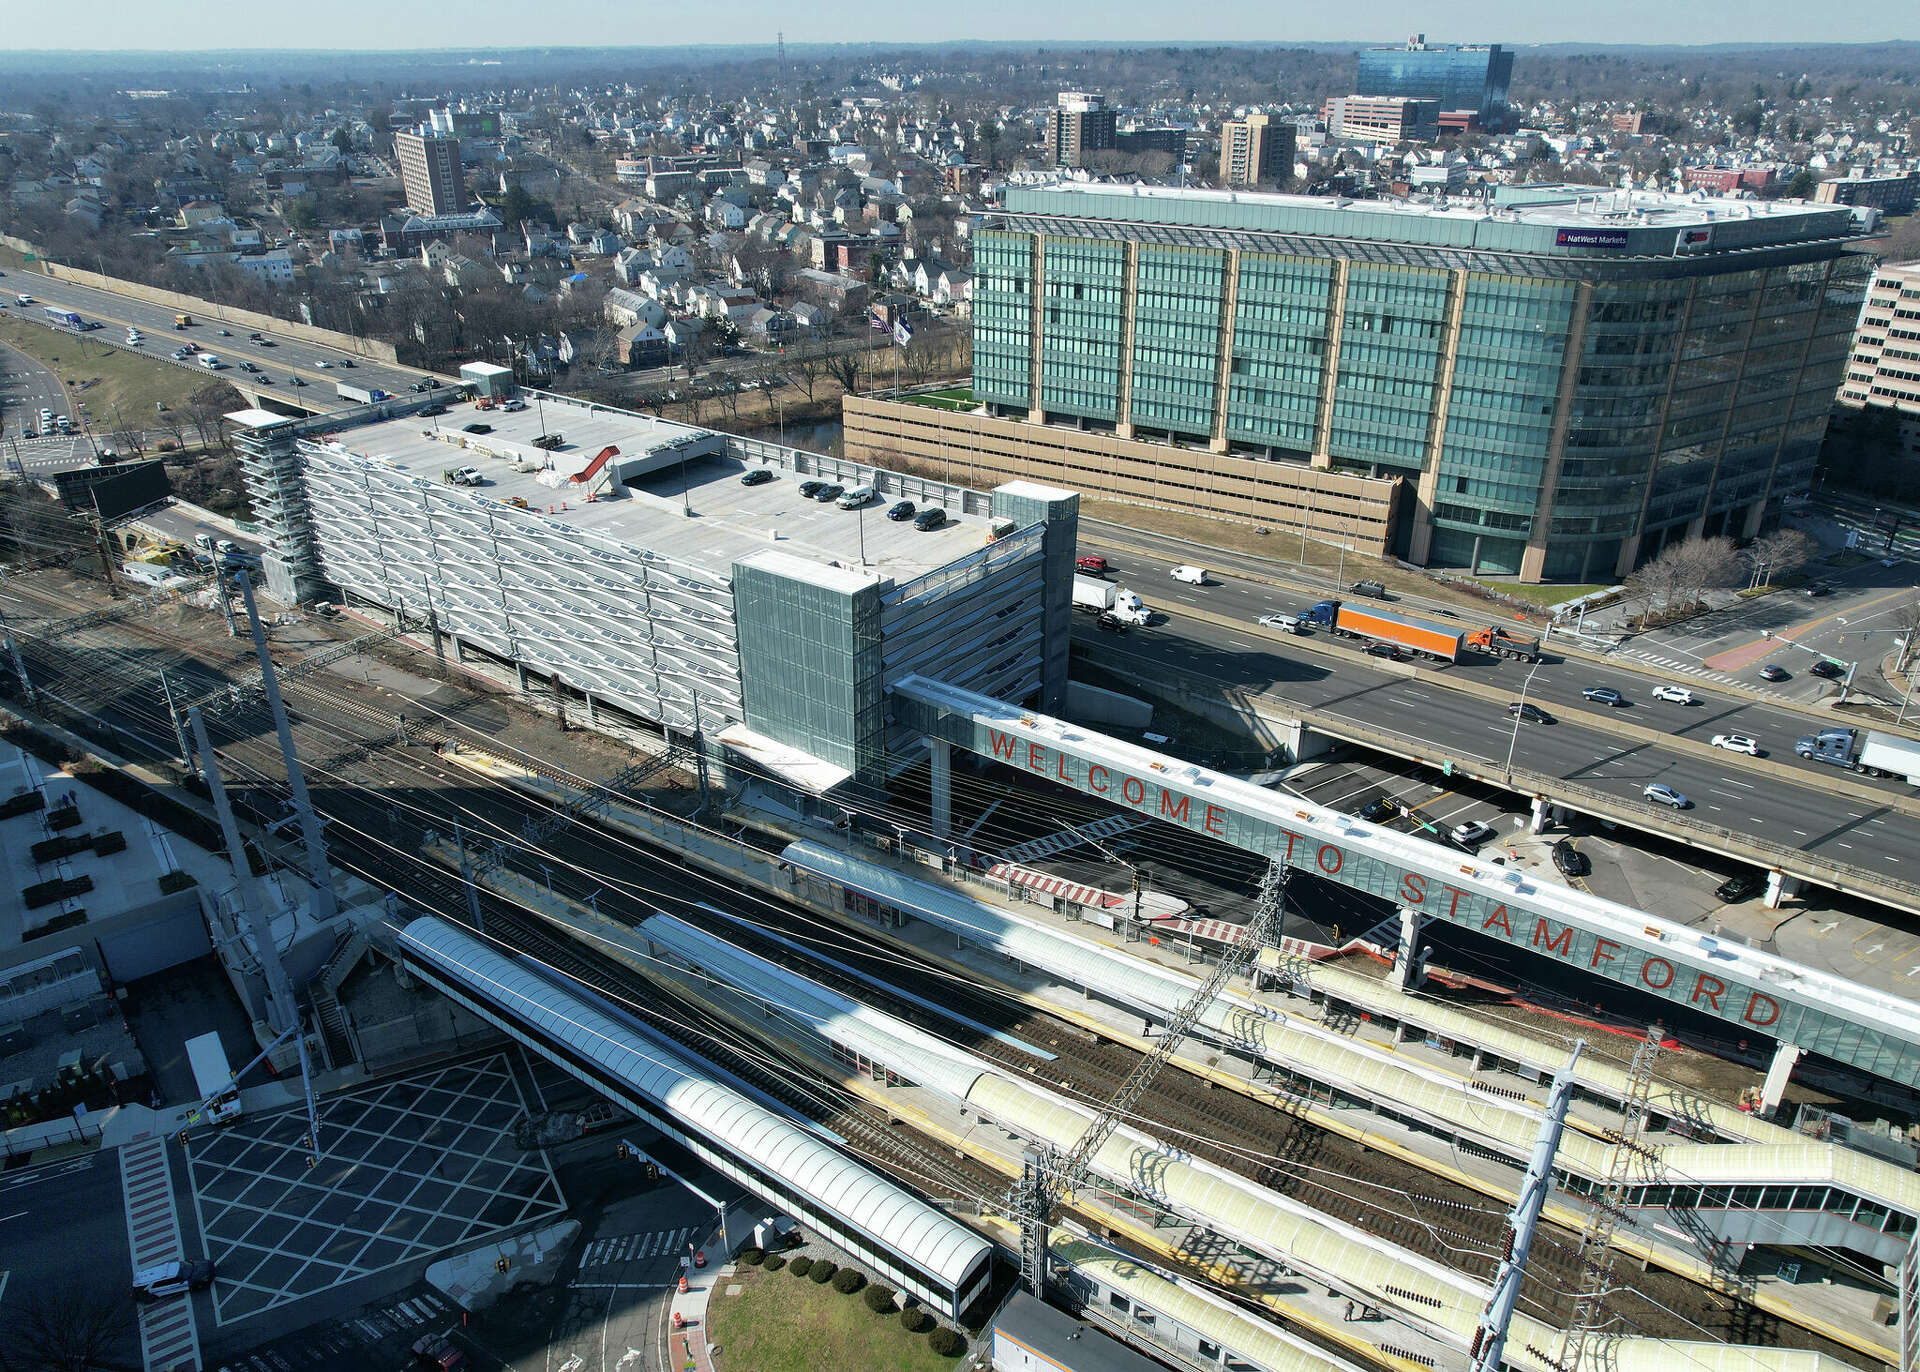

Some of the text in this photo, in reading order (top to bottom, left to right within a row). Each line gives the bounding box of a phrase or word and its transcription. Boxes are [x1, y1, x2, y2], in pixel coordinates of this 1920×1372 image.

[1567, 234, 1627, 245] NatWest Markets
[990, 729, 1780, 1026] WELCOME TO STAMFORD
